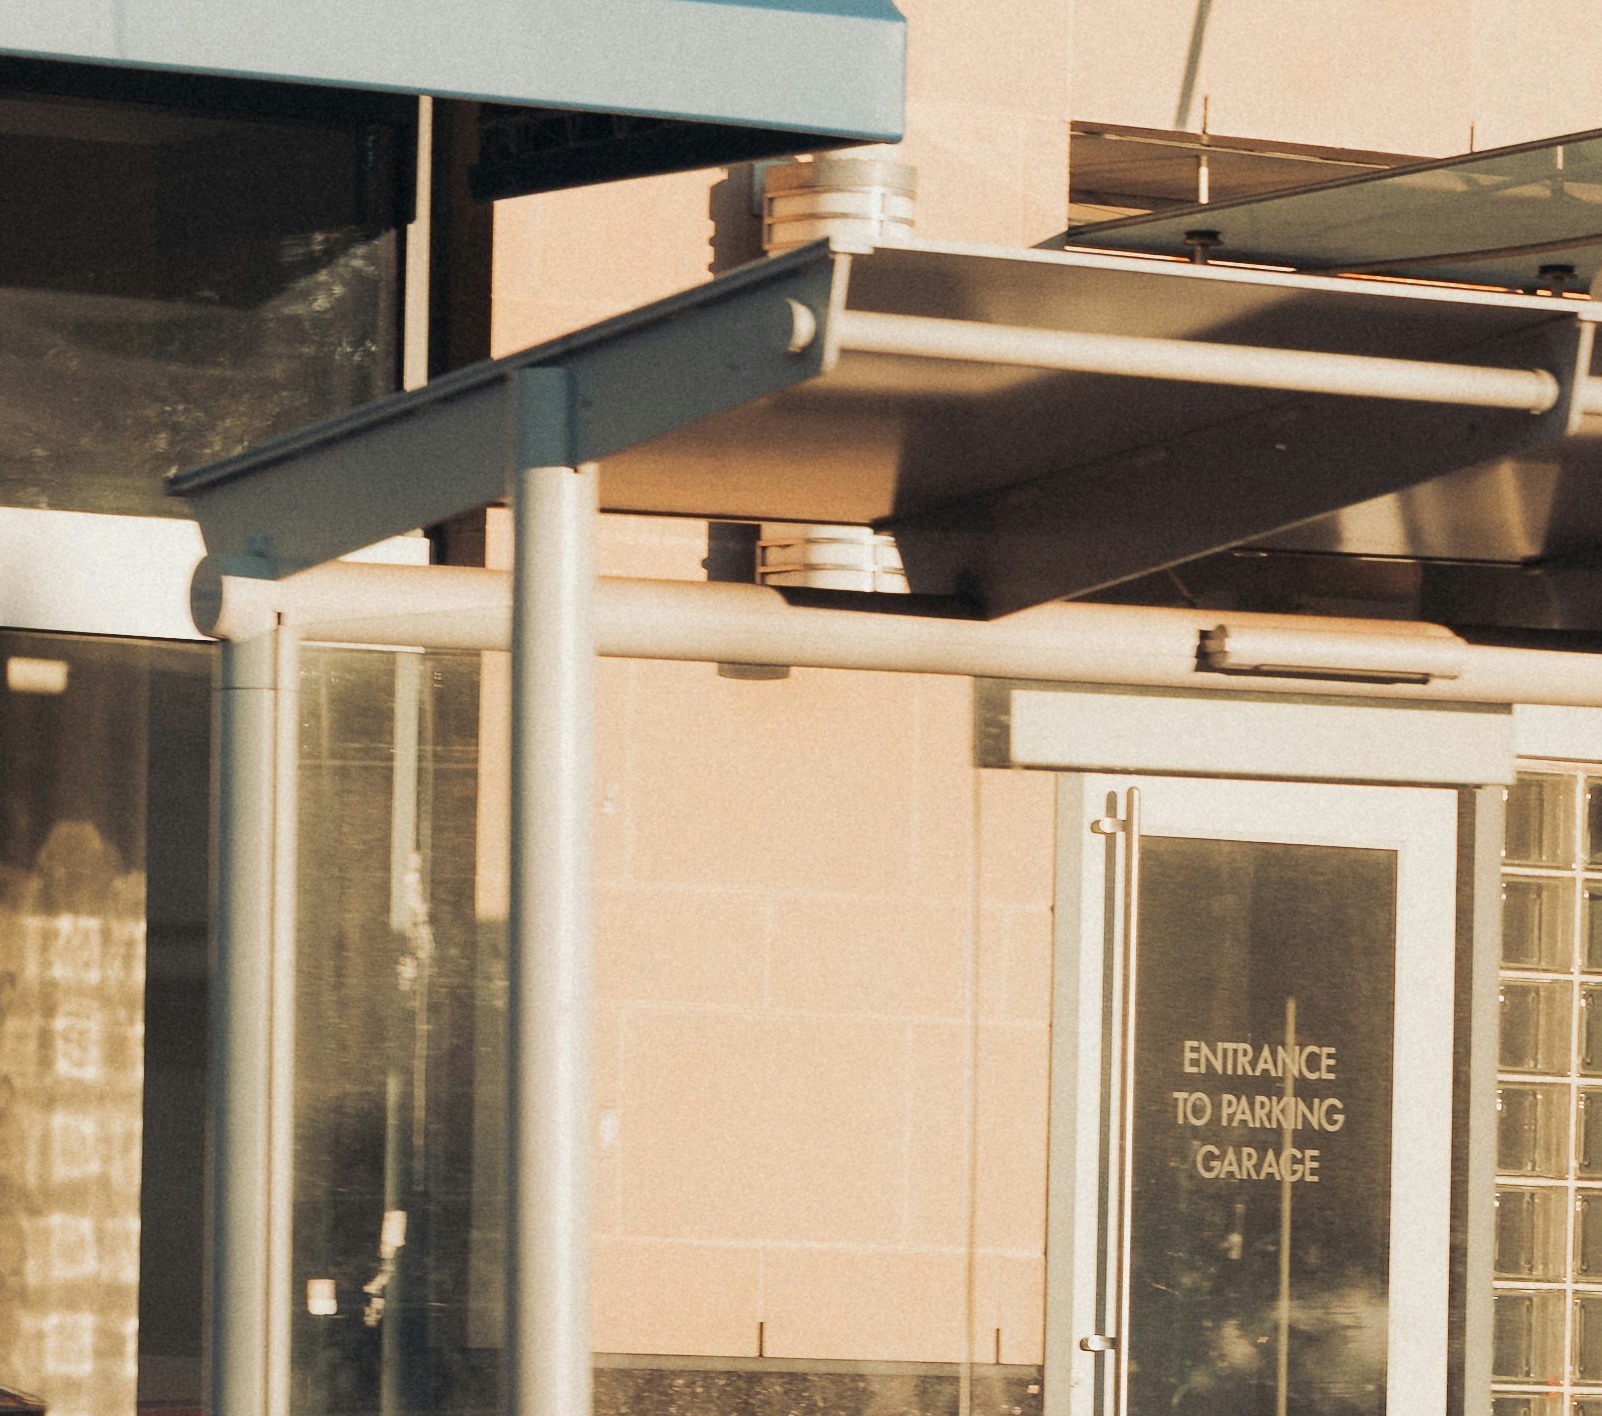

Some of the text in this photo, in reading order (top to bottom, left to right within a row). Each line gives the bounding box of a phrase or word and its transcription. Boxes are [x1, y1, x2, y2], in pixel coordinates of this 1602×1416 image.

[1183, 1040, 1336, 1080] ENTRANCE
[1173, 1091, 1345, 1132] TO PARKING
[1197, 1144, 1320, 1182] GARAGE
